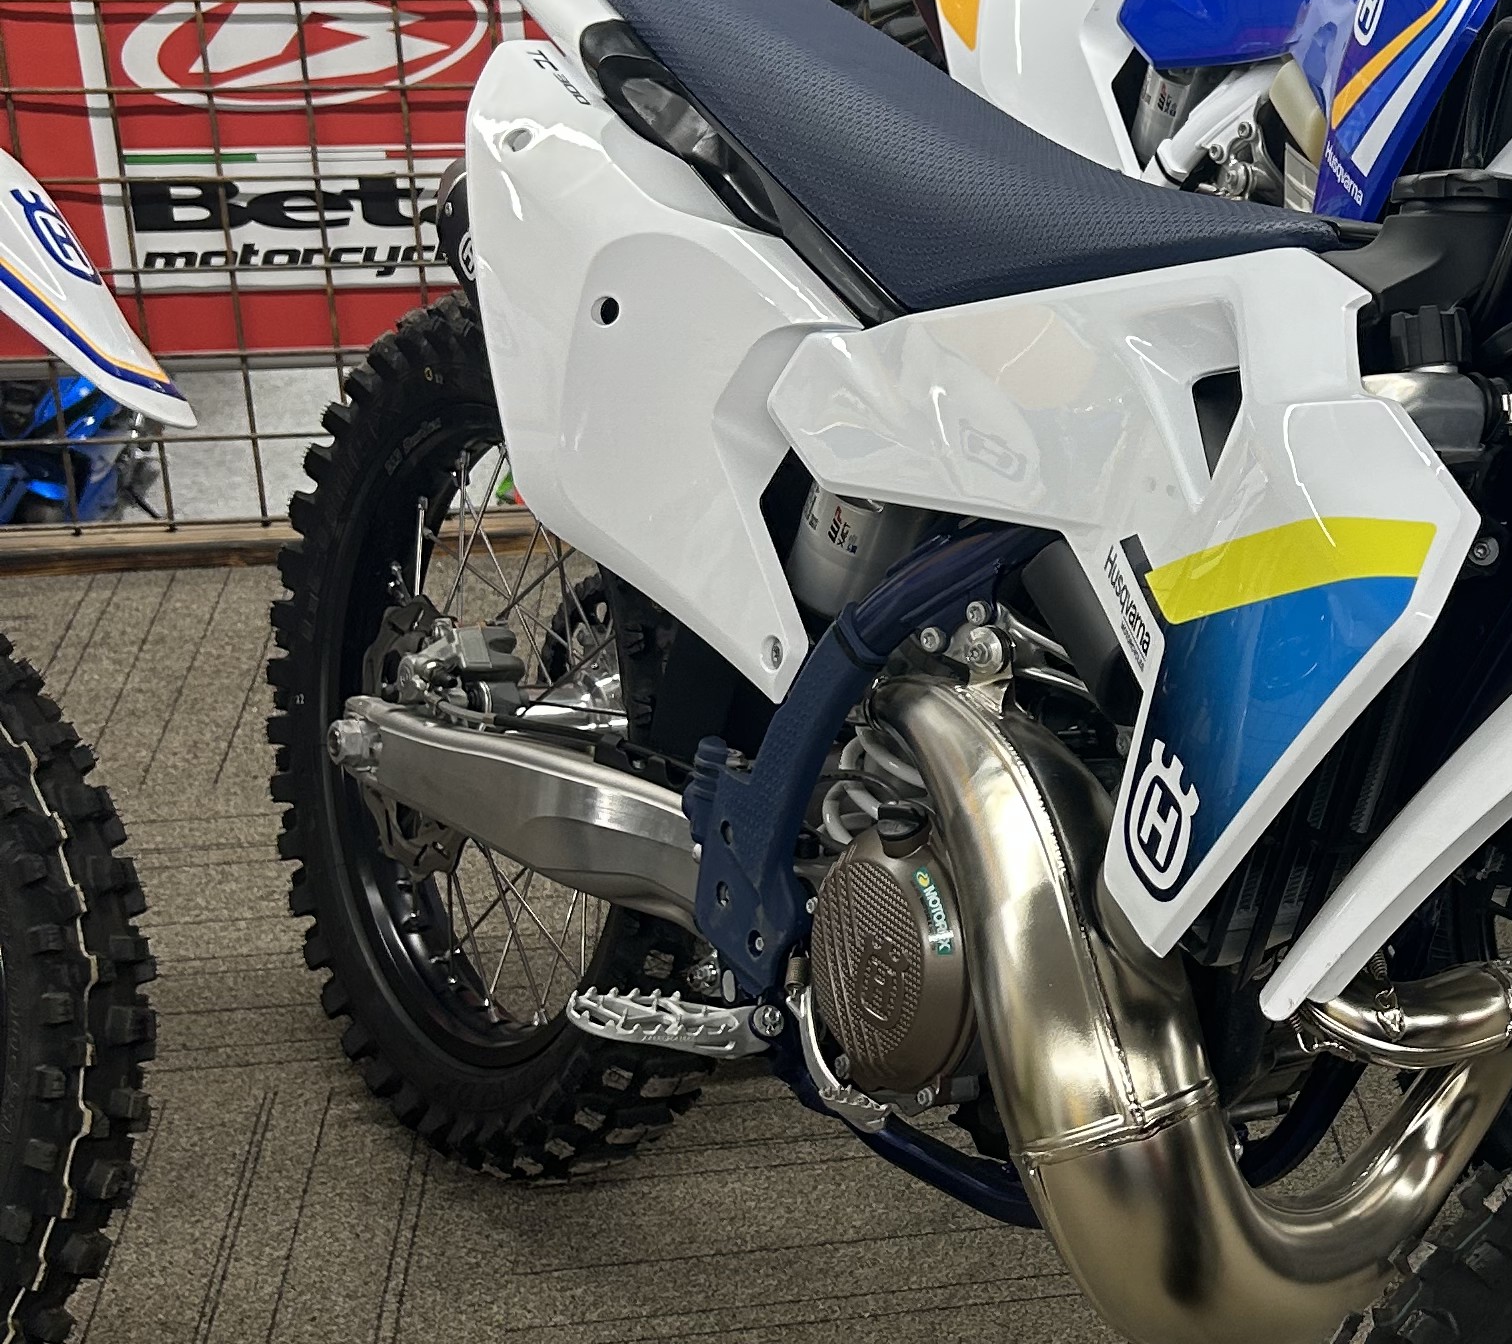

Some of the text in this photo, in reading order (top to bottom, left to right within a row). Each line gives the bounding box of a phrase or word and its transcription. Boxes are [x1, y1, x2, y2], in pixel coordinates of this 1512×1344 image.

[526, 49, 592, 106] TC 300
[1325, 140, 1364, 206] Husqvarna
[1103, 544, 1151, 657] Husqvarna
